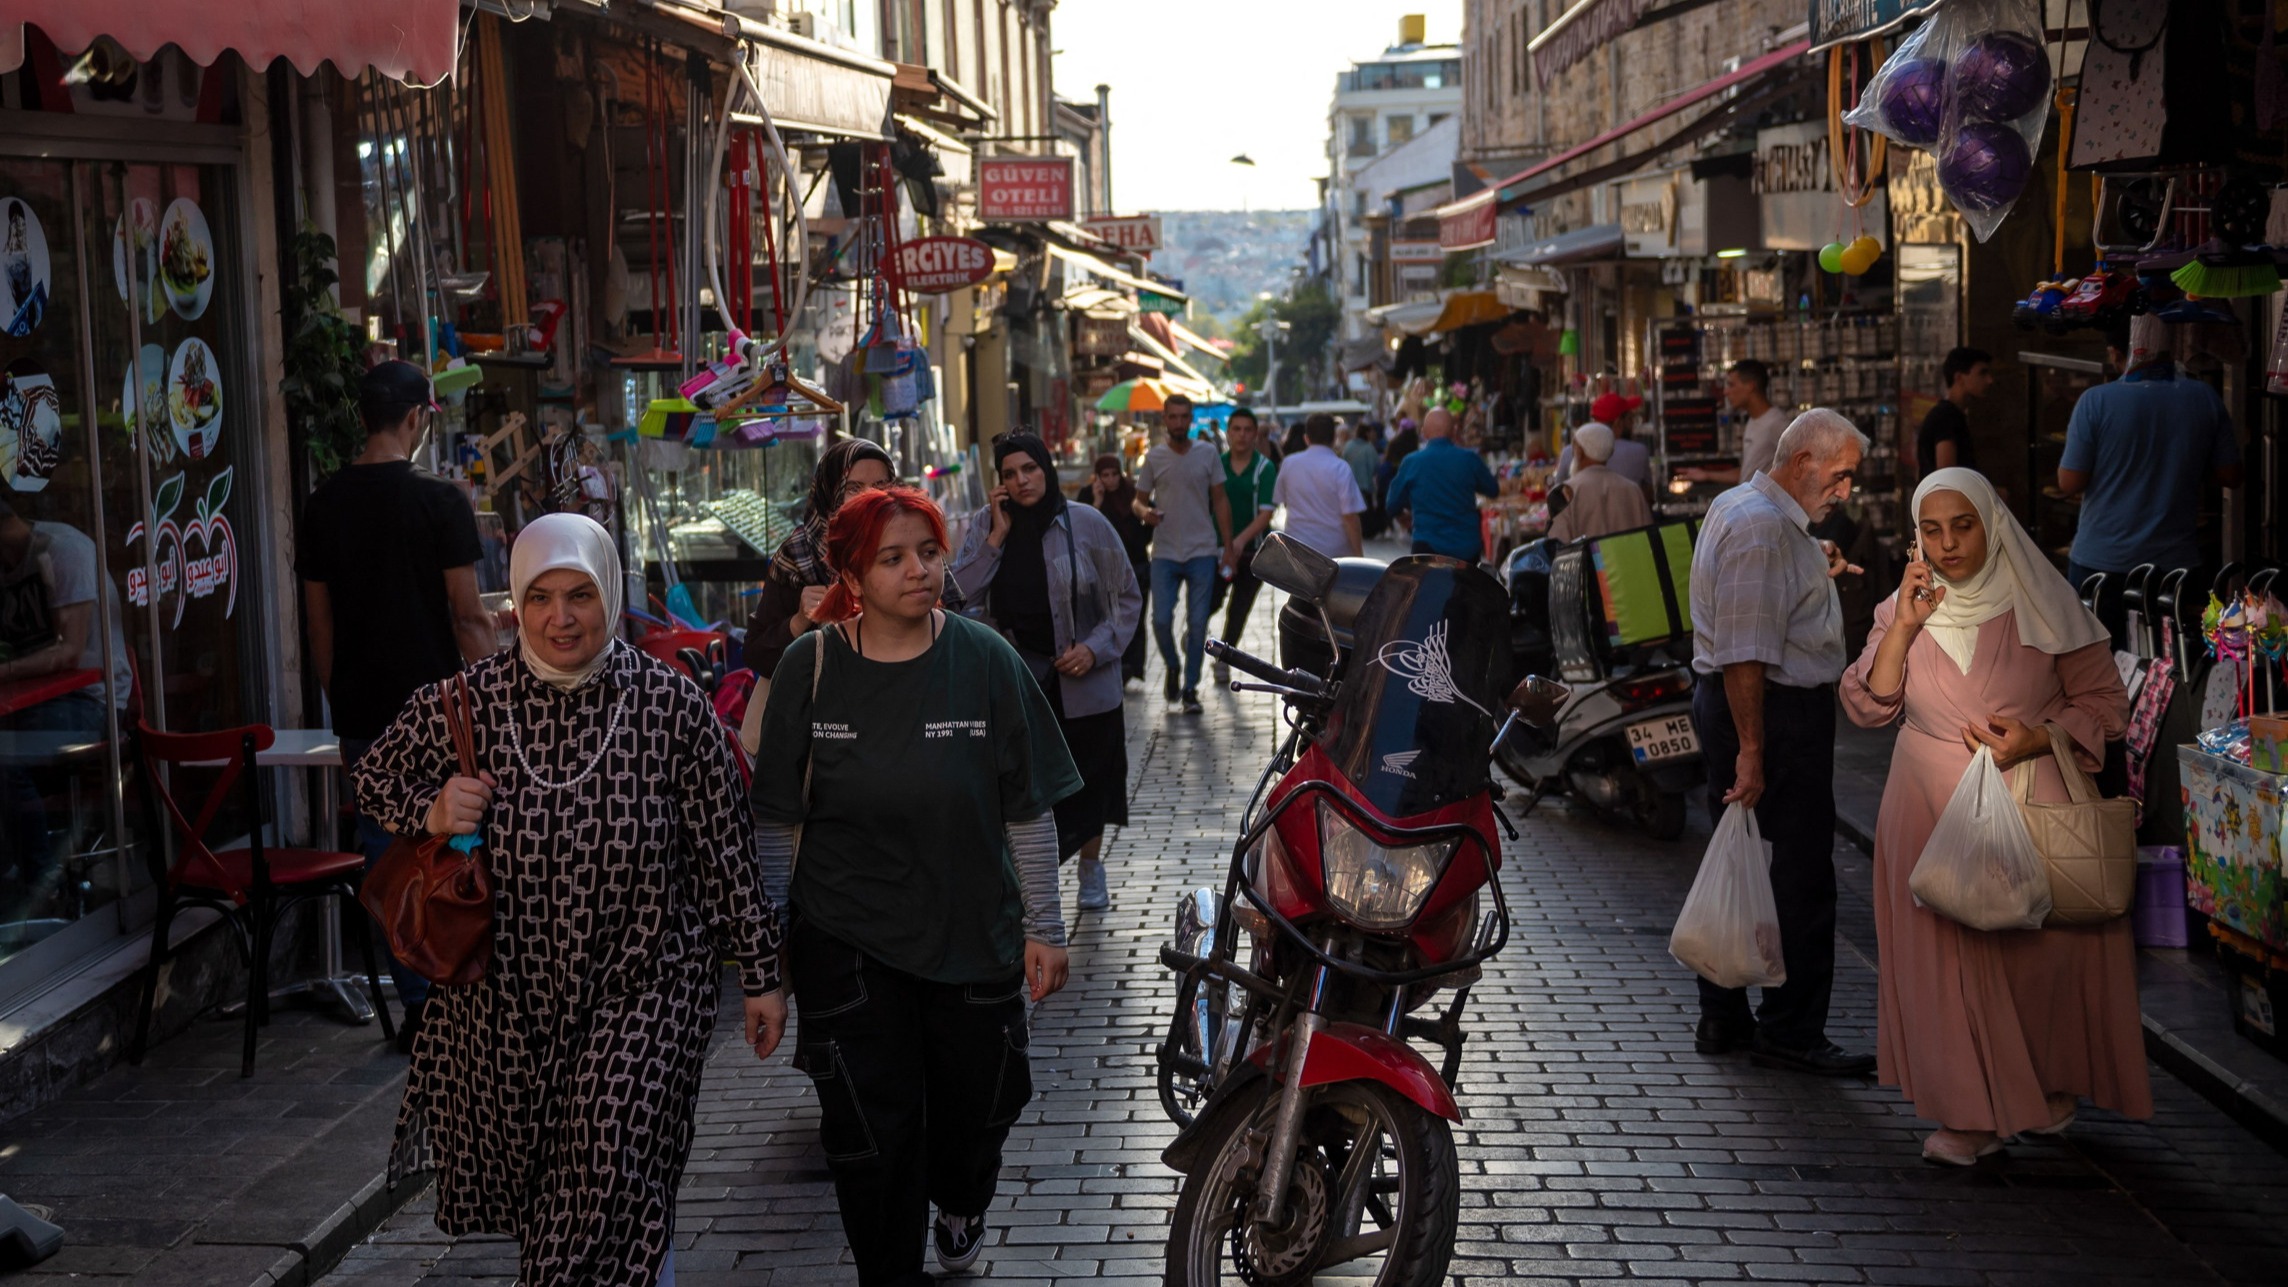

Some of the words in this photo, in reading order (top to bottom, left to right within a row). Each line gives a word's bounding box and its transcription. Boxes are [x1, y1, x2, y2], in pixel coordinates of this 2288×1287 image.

[985, 164, 1065, 182] GÜVEN
[991, 185, 1059, 203] OTELİ
[906, 271, 970, 286] ELEKTRİK
[823, 723, 849, 731] EVOLVE
[925, 721, 969, 730] MANHATTAN
[1630, 726, 1653, 743] 34
[1665, 718, 1690, 736] ME
[812, 730, 824, 738] ON
[937, 730, 953, 738] 1991
[1648, 736, 1692, 757] 0850
[1381, 765, 1417, 780] HONDA
